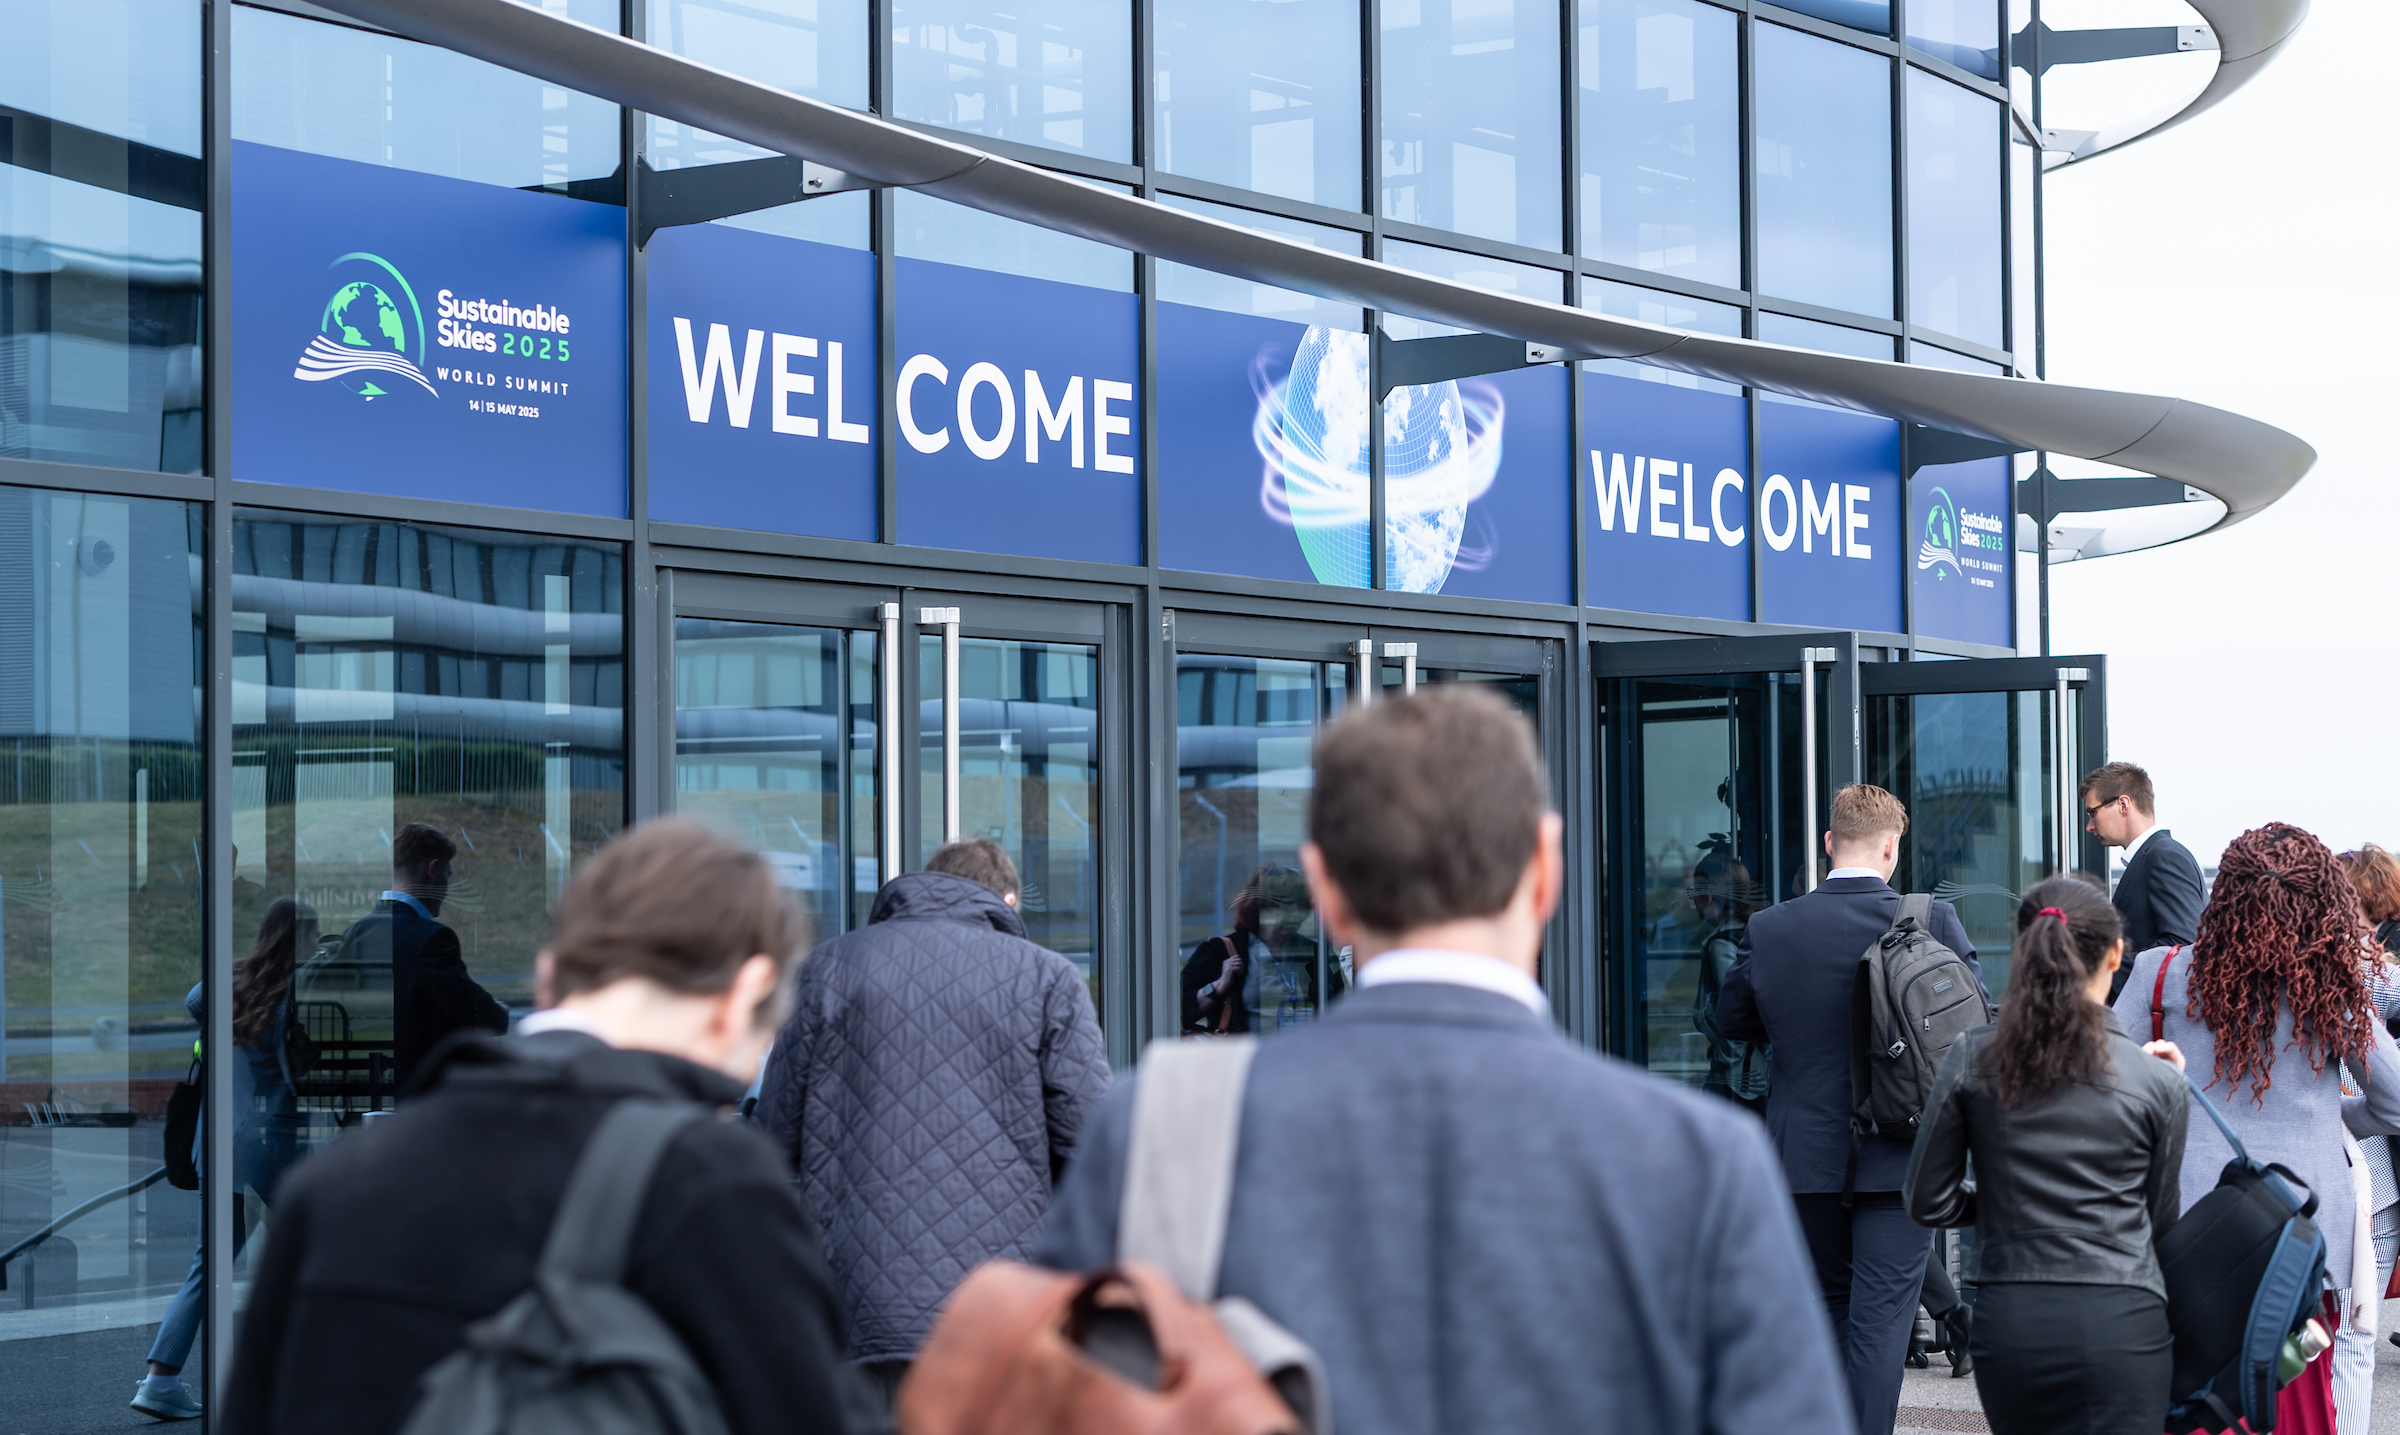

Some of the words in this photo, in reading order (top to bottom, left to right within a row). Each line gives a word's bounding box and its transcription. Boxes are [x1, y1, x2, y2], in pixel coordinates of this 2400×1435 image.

[437, 289, 570, 334] Sustainable
[437, 318, 497, 353] Skies
[502, 332, 570, 362] 2025
[437, 366, 496, 387] WORLD
[505, 376, 568, 396] SUMMIT
[673, 317, 1134, 475] WELCOME
[497, 403, 517, 416] MAY
[518, 405, 540, 419] 2025
[1591, 450, 1871, 559] WELCOME
[1960, 507, 2003, 534] Sustainable
[1960, 526, 1980, 548] Skies
[1980, 533, 2003, 552] 2025
[1960, 557, 1980, 569] WORLD
